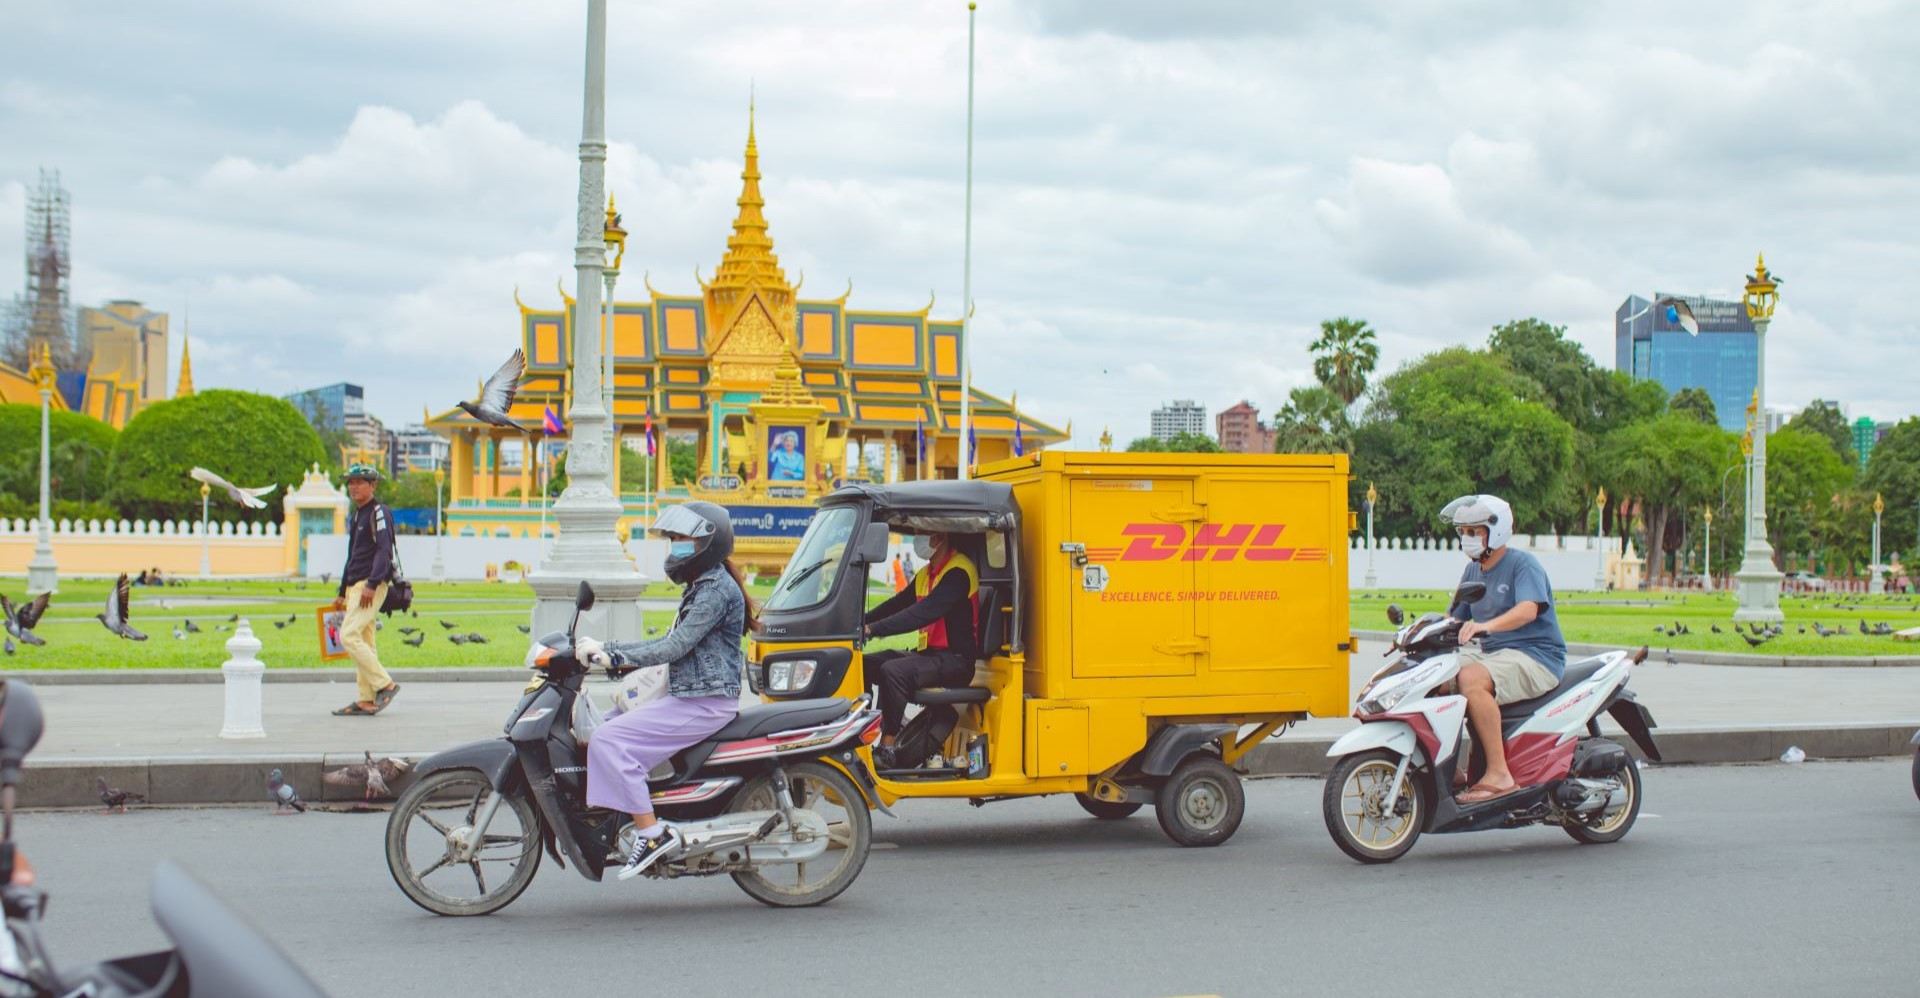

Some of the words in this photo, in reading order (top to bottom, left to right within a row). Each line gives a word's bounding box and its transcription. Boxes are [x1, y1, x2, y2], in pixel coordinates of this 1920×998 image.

[1120, 523, 1296, 562] DHL
[1101, 591, 1175, 602] EXCELLENCE.
[1177, 591, 1216, 601] SIMPLY
[1218, 590, 1281, 601] DELIVERED.
[554, 766, 588, 774] HONDA
